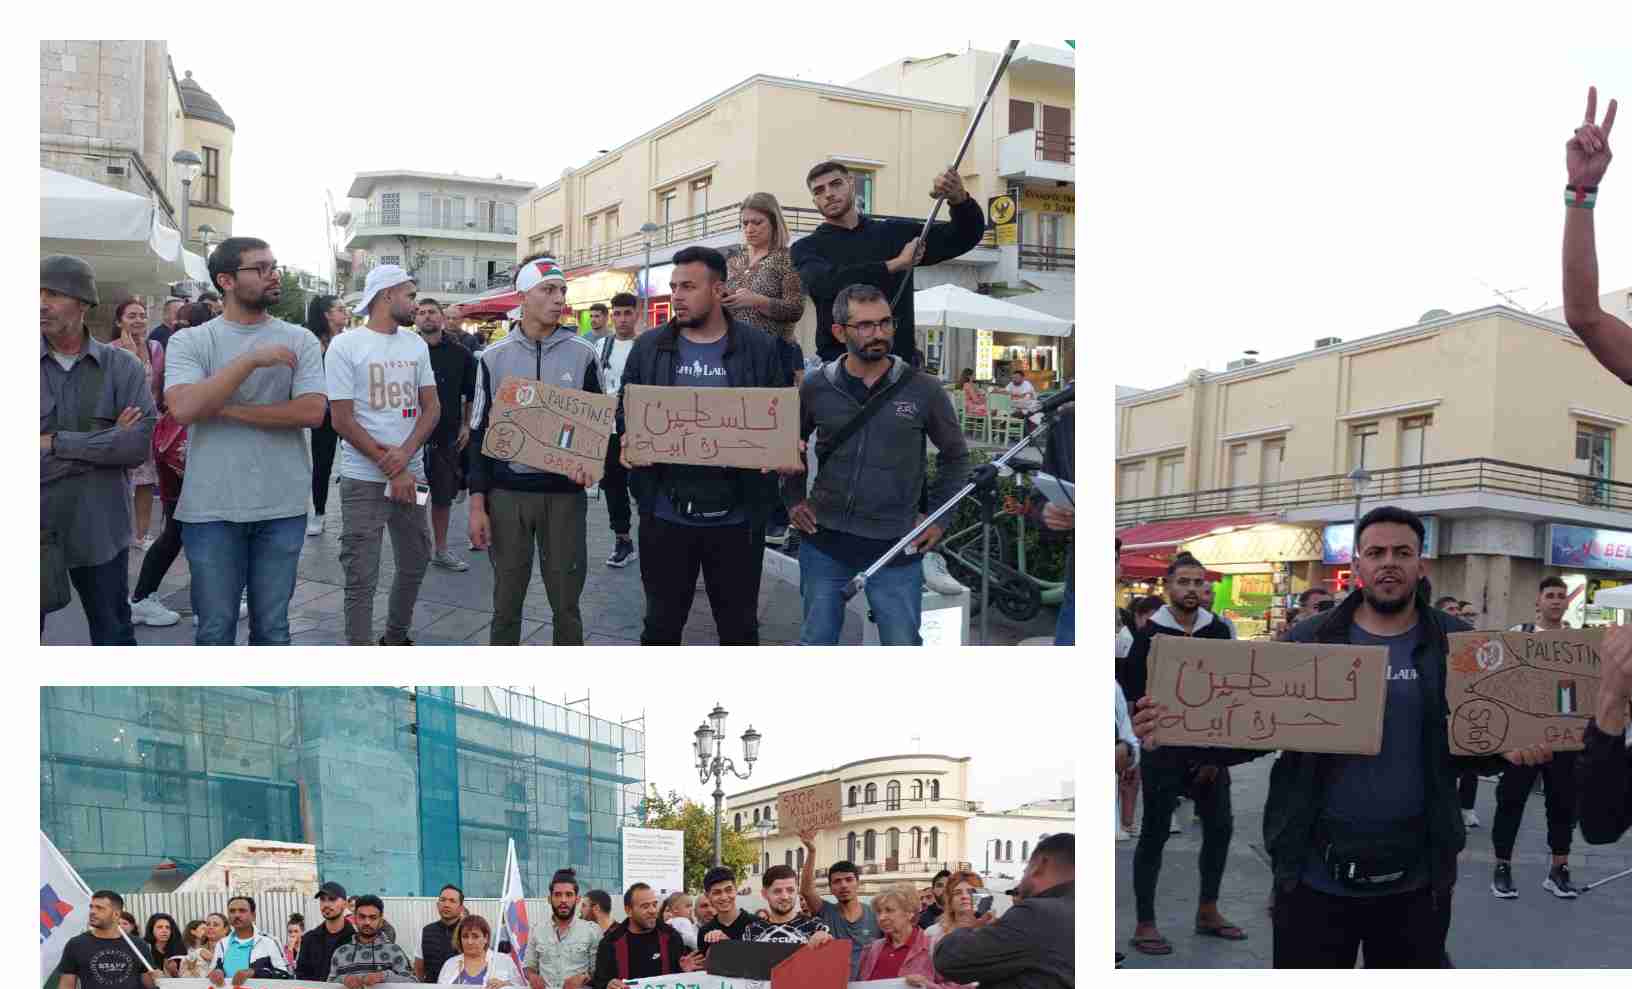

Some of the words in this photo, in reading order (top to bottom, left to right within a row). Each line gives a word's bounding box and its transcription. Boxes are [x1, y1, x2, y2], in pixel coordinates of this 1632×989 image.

[640, 391, 779, 436] فلسطين
[697, 436, 768, 460] حرة
[1525, 637, 1600, 669] PALESTIN
[1176, 648, 1362, 708] فلسطين
[1248, 708, 1344, 740] حرة
